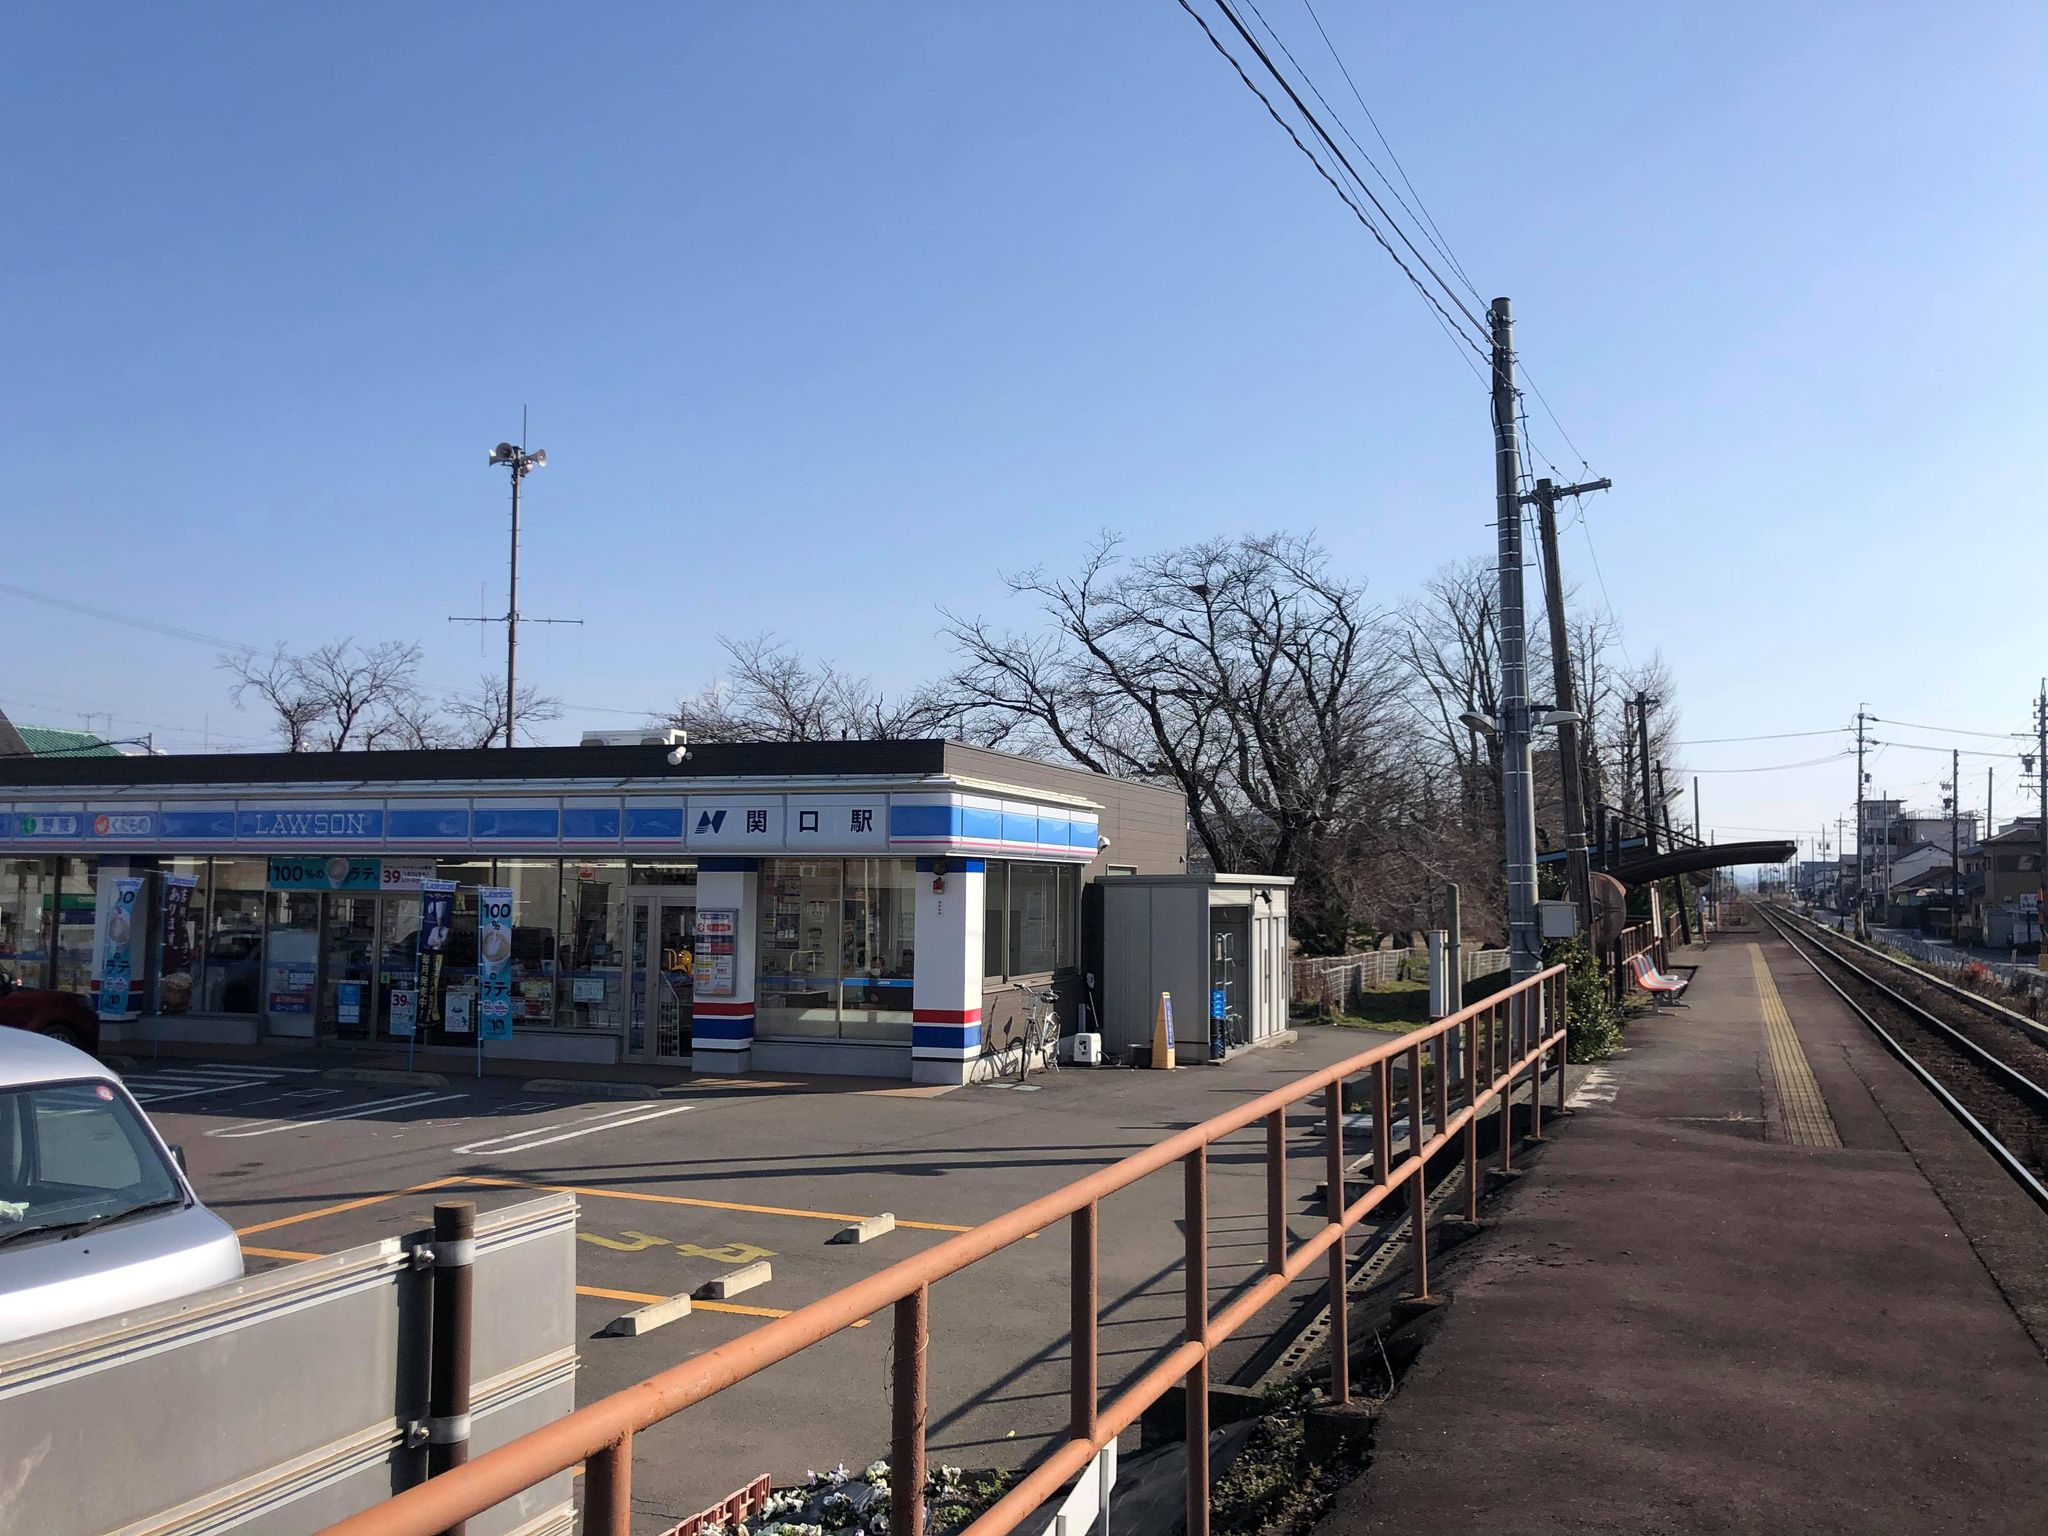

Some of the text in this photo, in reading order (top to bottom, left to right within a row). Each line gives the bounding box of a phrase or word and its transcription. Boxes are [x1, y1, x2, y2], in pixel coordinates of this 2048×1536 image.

[255, 813, 365, 834] LAWSON
[746, 809, 873, 833] 関口駅
[484, 903, 511, 918] 100
